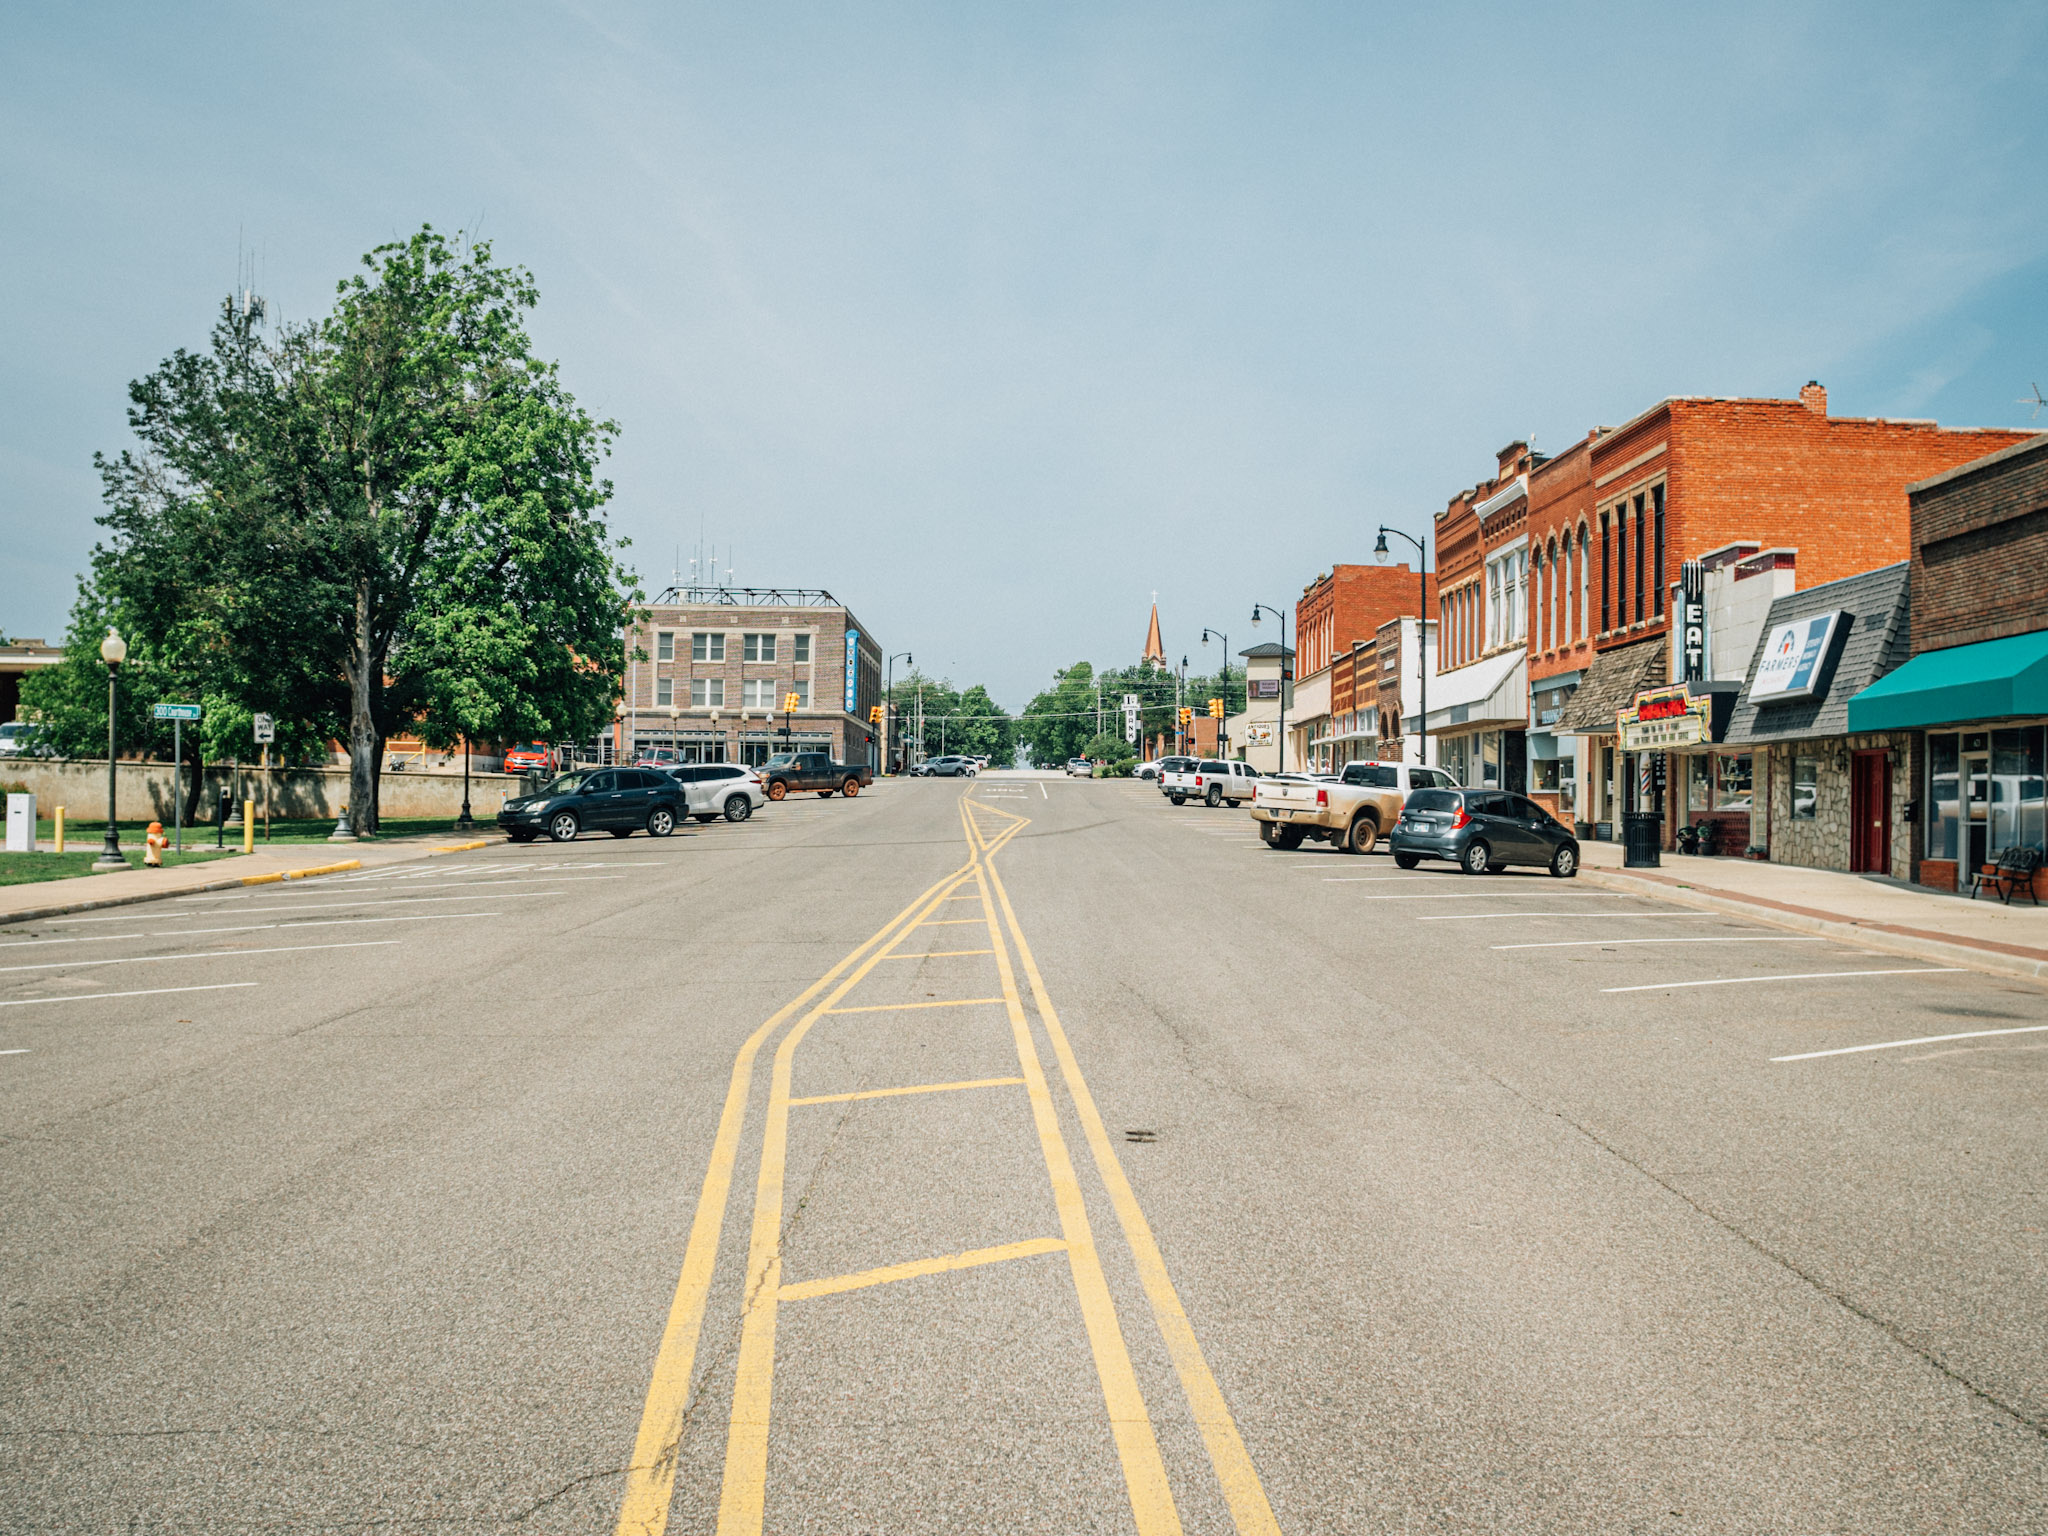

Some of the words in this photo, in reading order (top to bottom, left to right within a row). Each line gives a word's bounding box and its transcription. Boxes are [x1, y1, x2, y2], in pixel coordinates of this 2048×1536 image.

[1686, 604, 1702, 667] EAT
[1760, 655, 1800, 672] FARMERS
[154, 706, 167, 716] 300
